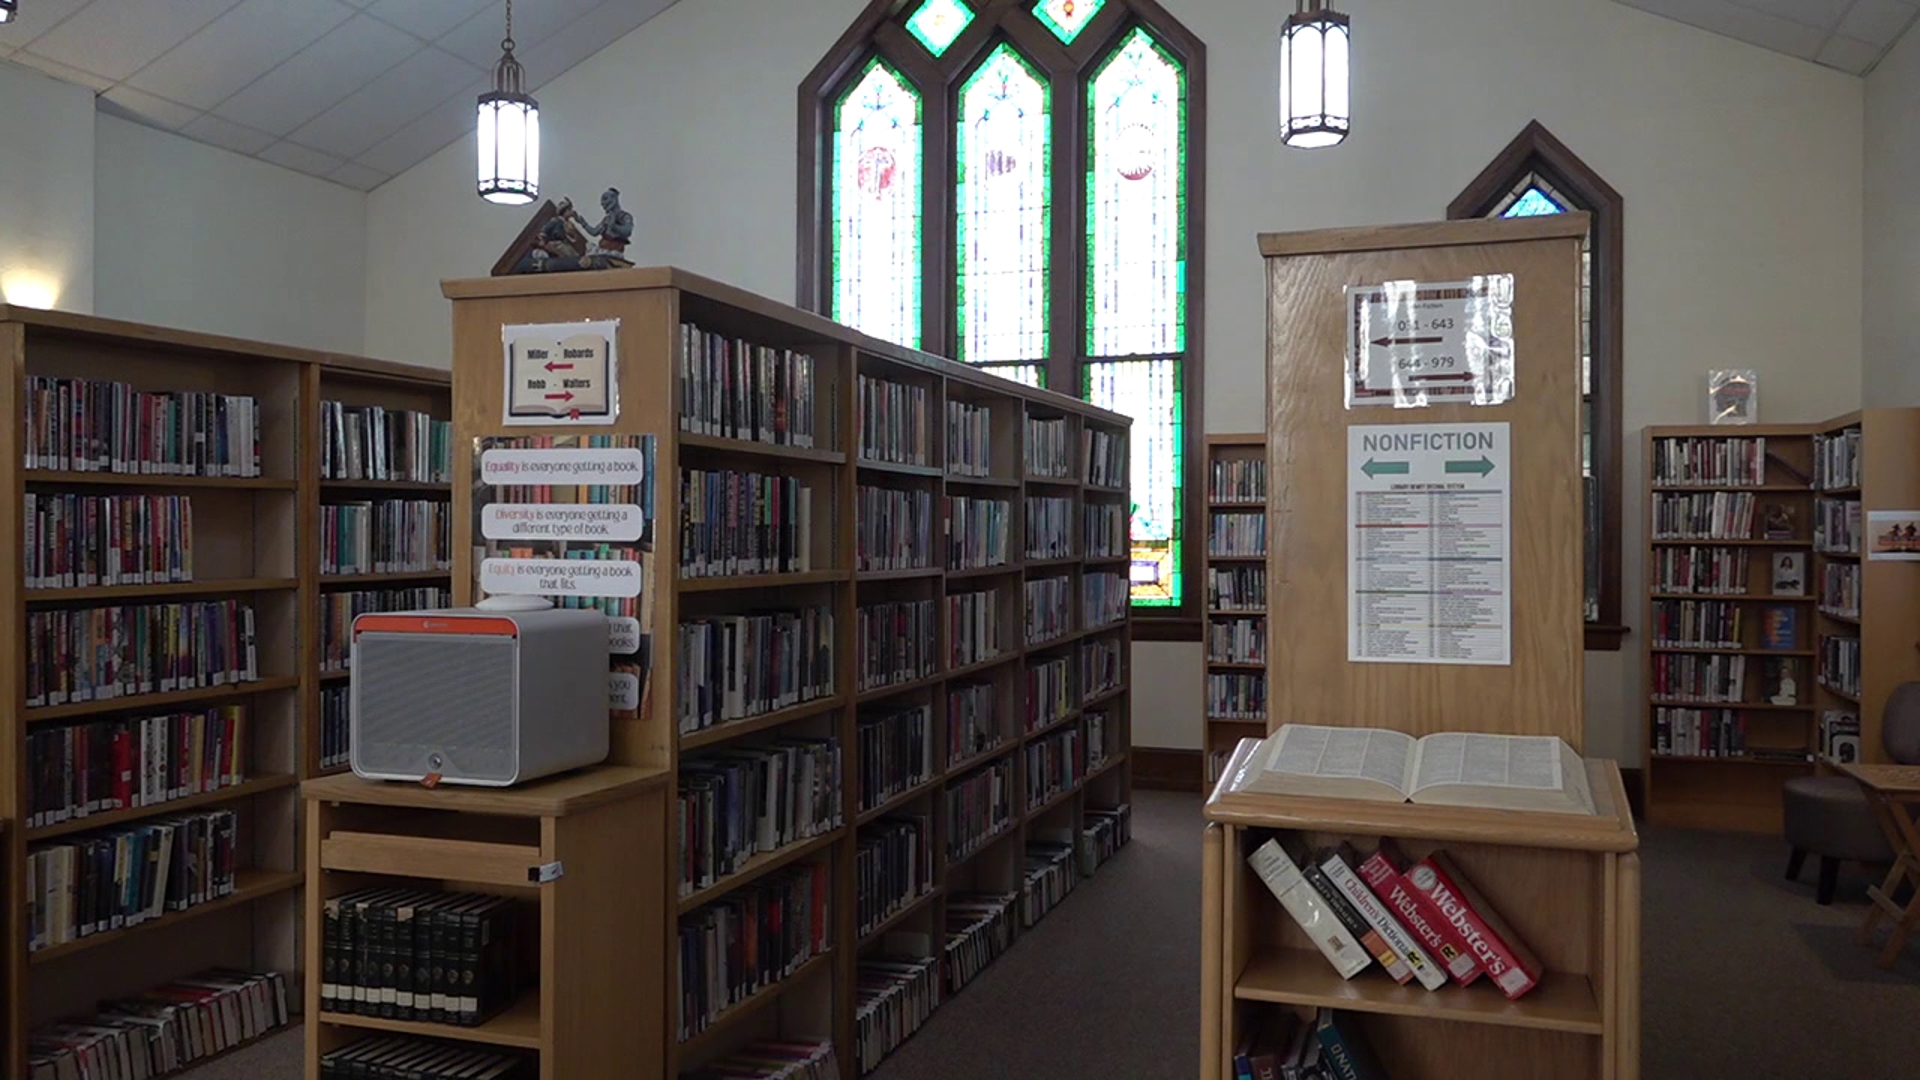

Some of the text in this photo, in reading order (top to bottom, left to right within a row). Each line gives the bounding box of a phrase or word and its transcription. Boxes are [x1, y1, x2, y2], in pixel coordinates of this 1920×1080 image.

[1431, 318, 1454, 330] 643
[527, 348, 548, 360] Miller
[563, 347, 594, 359] Robards
[1431, 356, 1454, 368] 979
[527, 379, 546, 389] Robb
[563, 378, 591, 388] Walters
[1363, 431, 1494, 451] NONFICTION
[485, 461, 521, 473] Equality
[522, 462, 530, 472] is
[531, 463, 571, 474] everyone
[573, 461, 605, 474] getting
[607, 463, 613, 472] a
[495, 510, 627, 524] Diversity is everyone getting a
[512, 523, 550, 534] different
[552, 524, 572, 536] type
[573, 524, 583, 534] of
[489, 564, 516, 576] Equity
[517, 564, 526, 574] is
[526, 565, 567, 577] everyone
[568, 564, 600, 578] getting
[602, 566, 608, 576] a
[539, 579, 576, 589] that fits.
[1345, 878, 1379, 920] Children's
[1377, 917, 1410, 956] Dictiona
[1390, 884, 1441, 948] Webster's
[1431, 882, 1505, 975] Webster's
